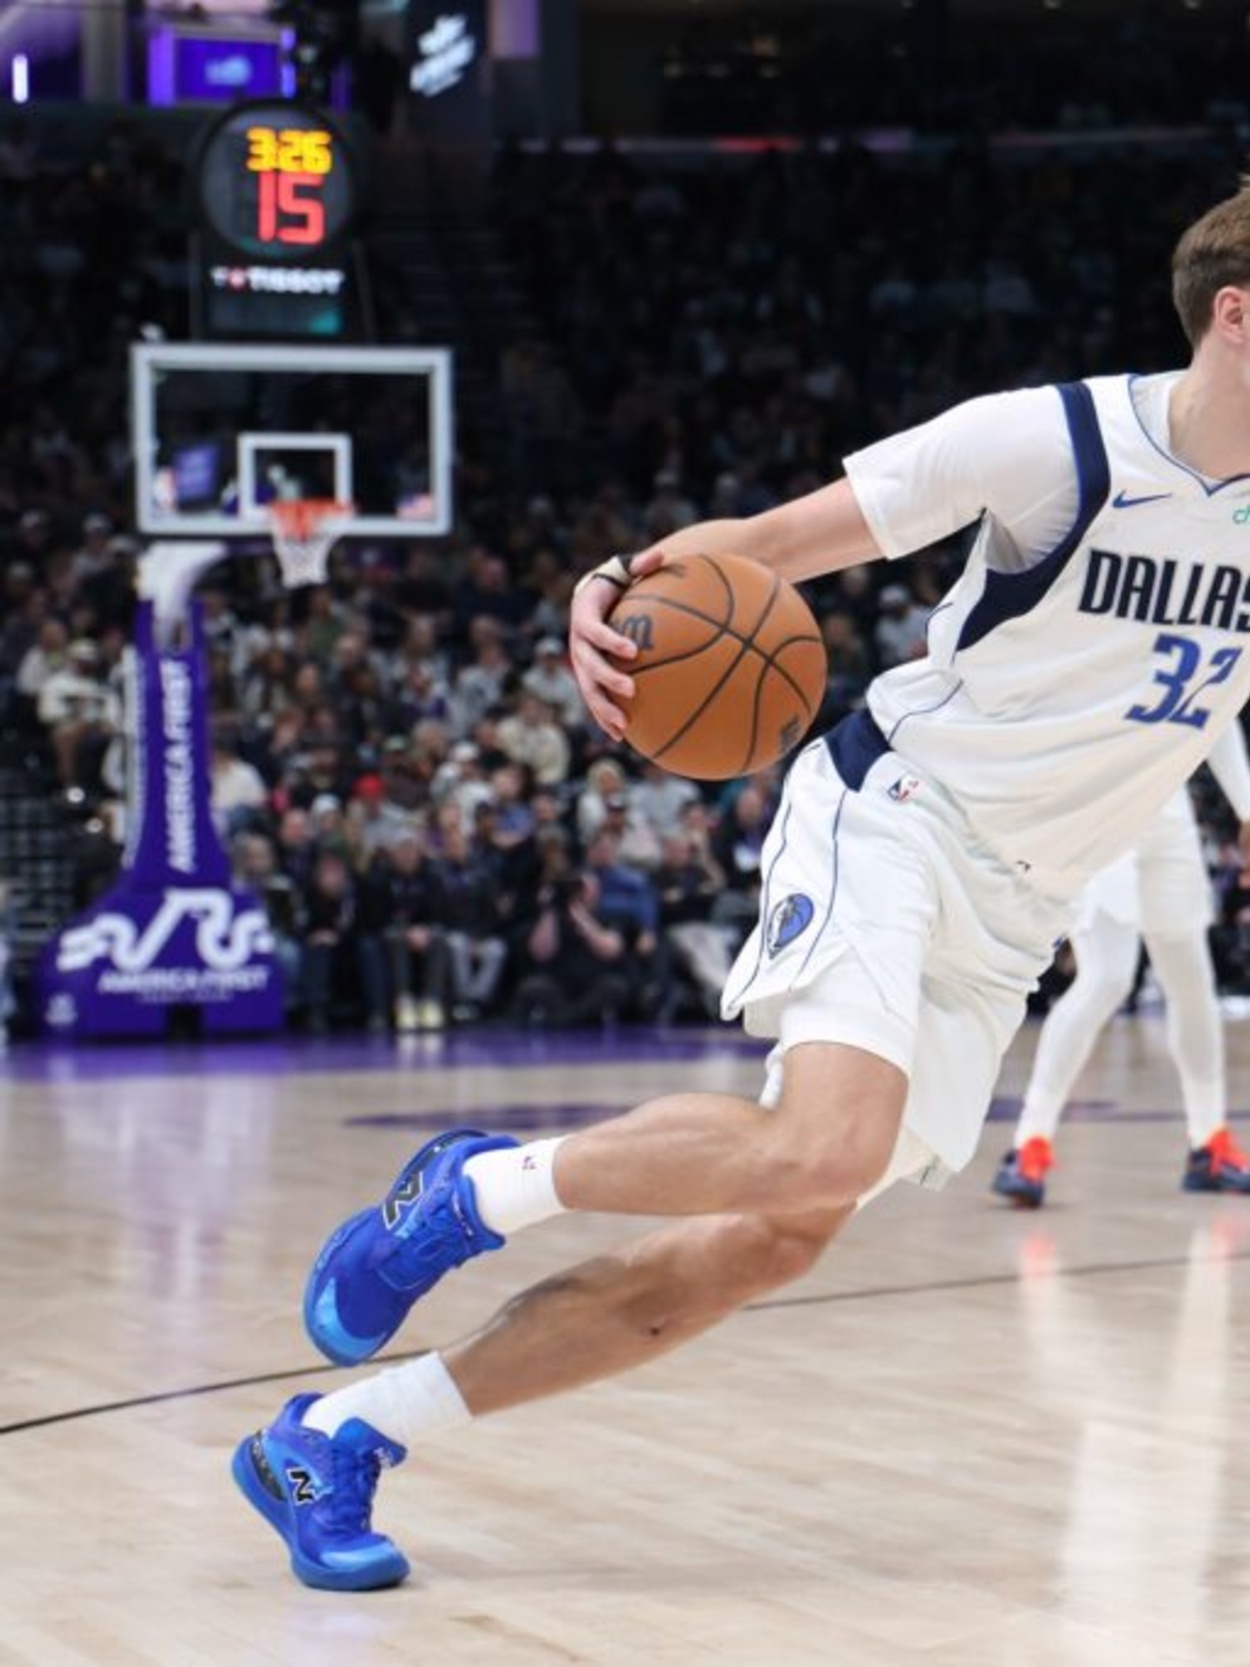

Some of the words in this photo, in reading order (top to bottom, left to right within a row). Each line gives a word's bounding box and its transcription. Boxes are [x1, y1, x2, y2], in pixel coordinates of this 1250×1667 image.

[257, 171, 326, 245] 15
[159, 660, 192, 742] FIRST
[1123, 633, 1244, 730] 32
[163, 743, 197, 874] AMERICA
